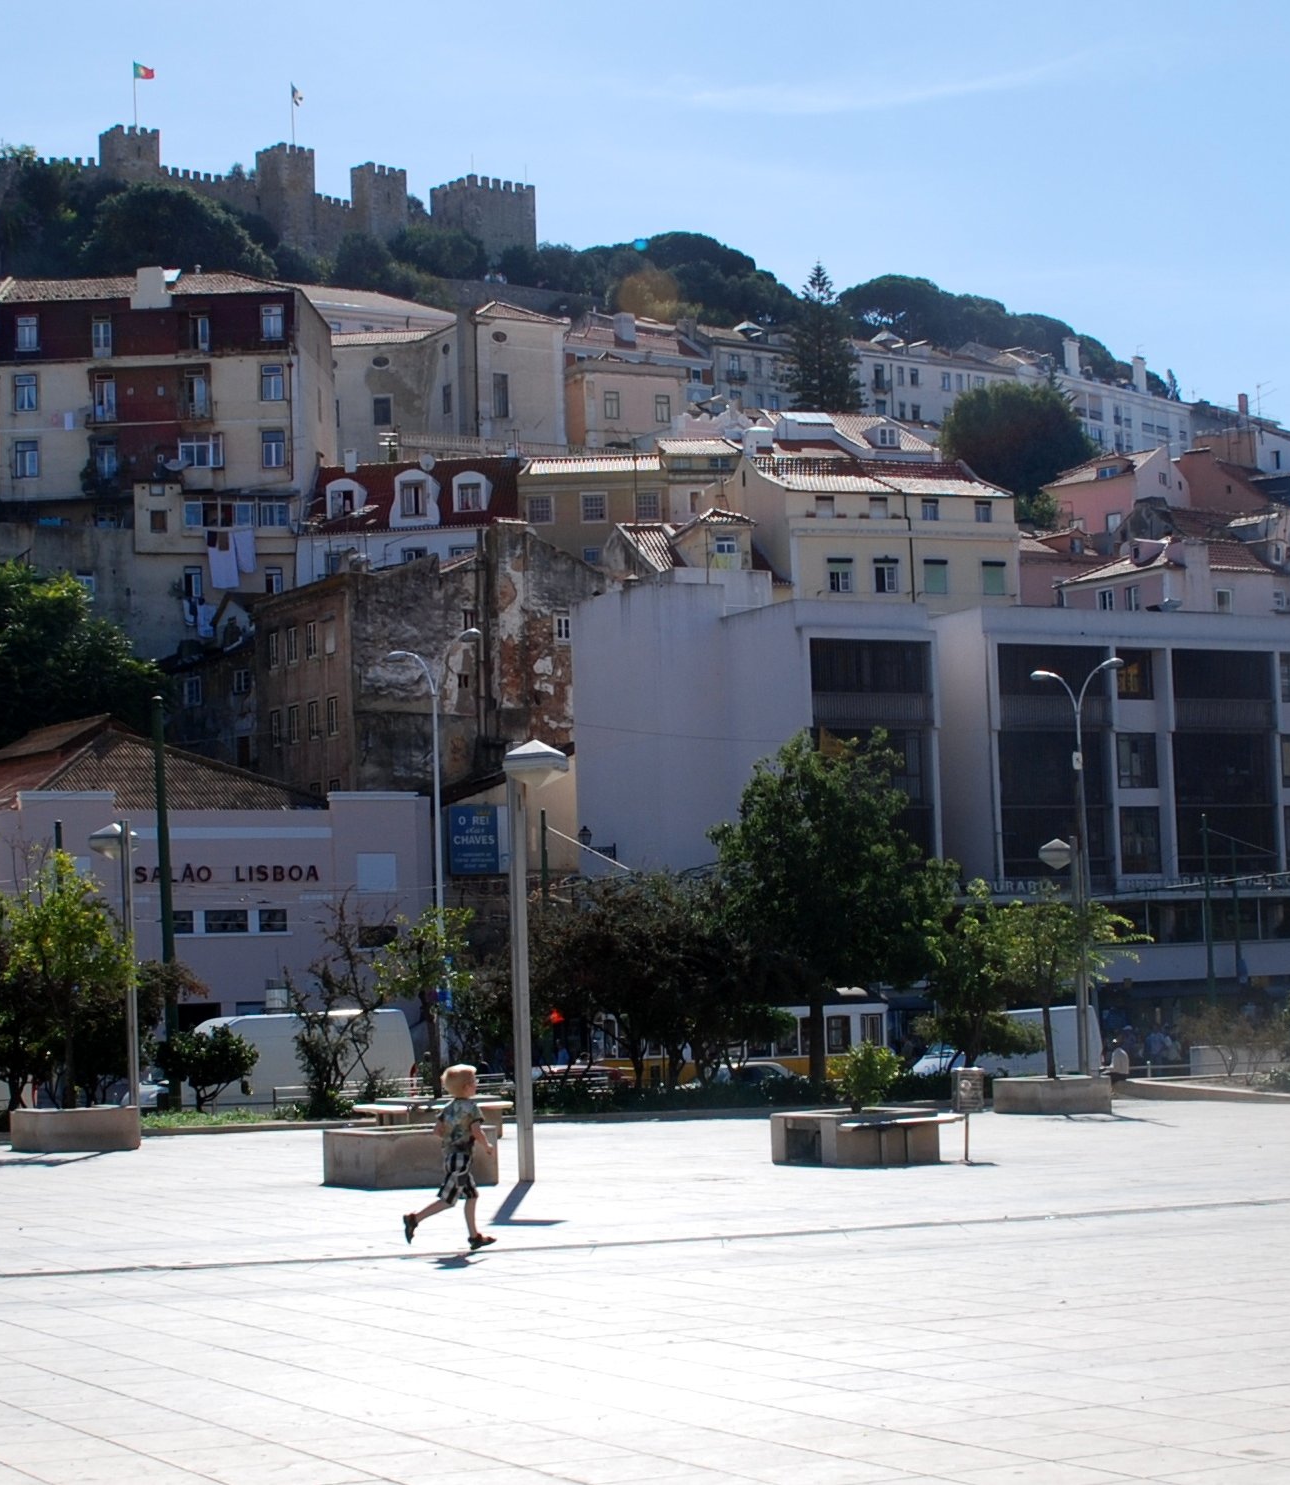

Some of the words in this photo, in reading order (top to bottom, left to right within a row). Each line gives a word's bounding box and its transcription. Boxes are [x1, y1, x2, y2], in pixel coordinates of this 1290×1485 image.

[458, 815, 467, 826] O
[472, 815, 490, 826] REI
[453, 835, 495, 845] CHAVES
[134, 863, 212, 883] SAÃO
[235, 864, 319, 882] LISBOA
